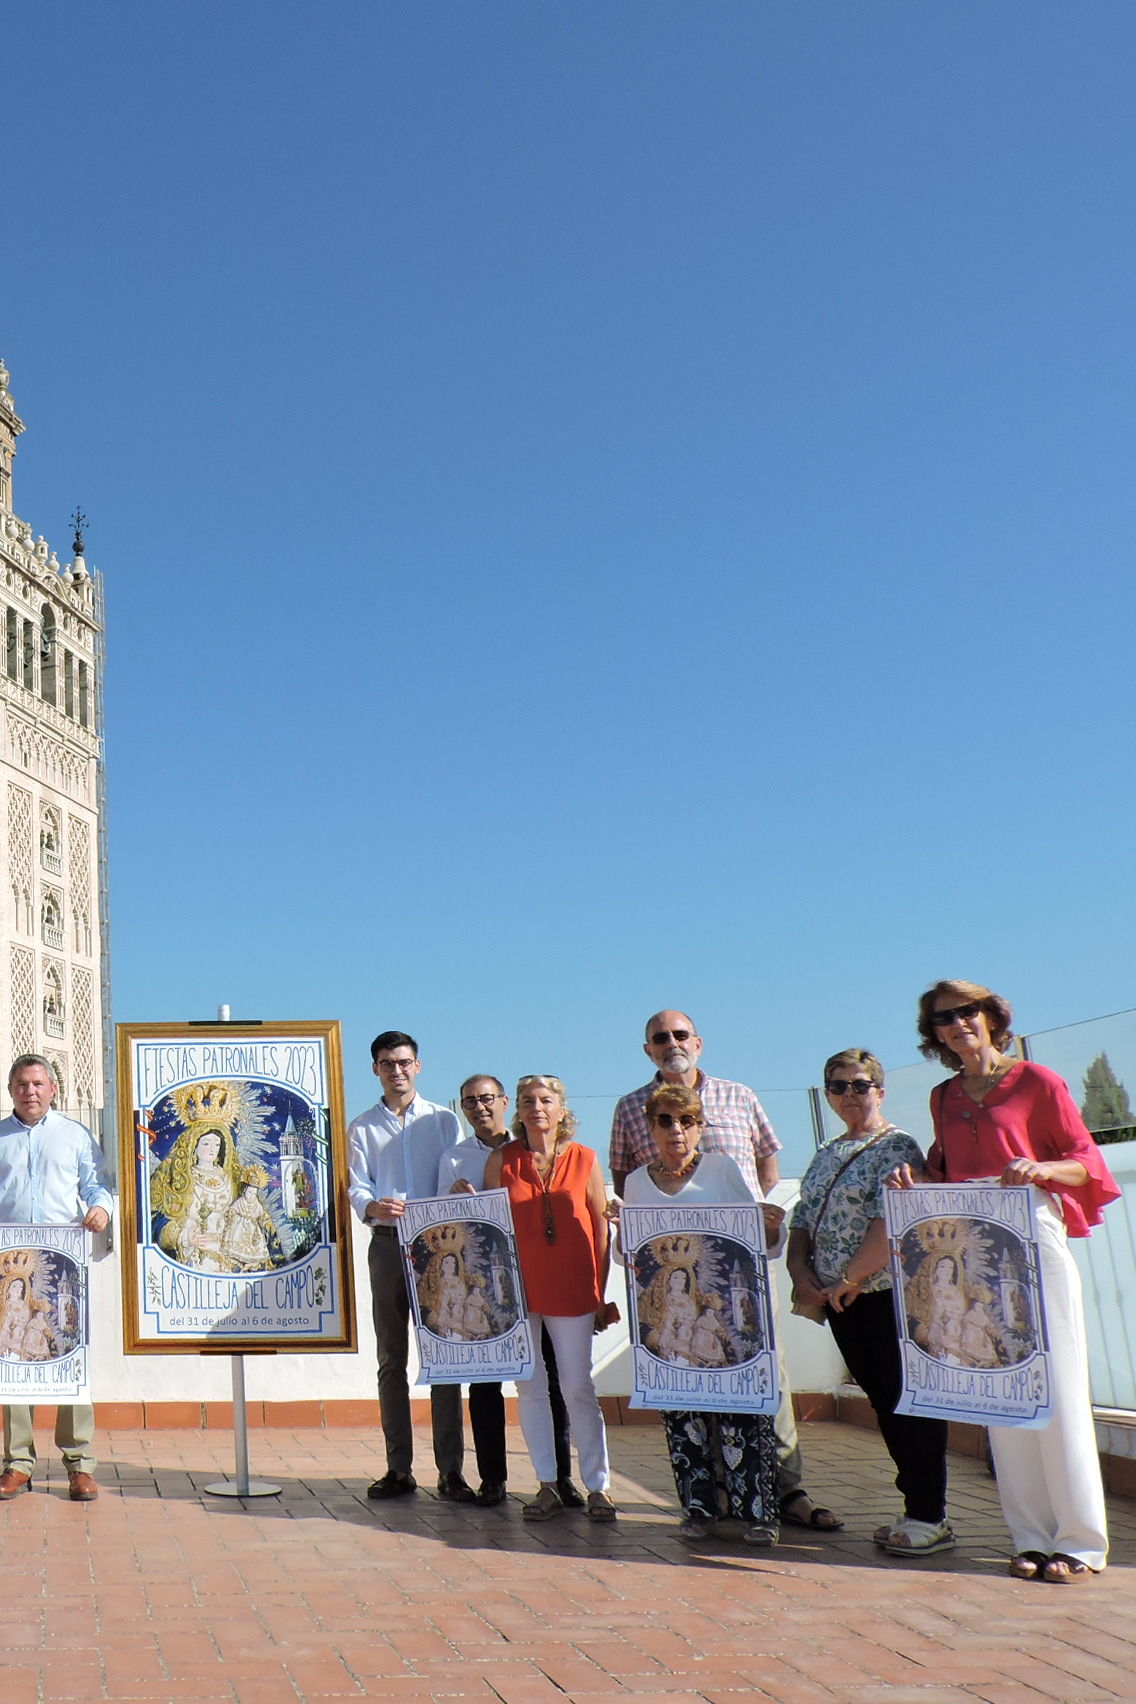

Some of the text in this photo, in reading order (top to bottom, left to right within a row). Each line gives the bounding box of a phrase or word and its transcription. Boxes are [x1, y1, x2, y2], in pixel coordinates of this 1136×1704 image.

[144, 1046, 316, 1097] FIESTAS PATRONALES 2023
[438, 1198, 485, 1218] PATRONALES
[892, 1192, 932, 1230] FIESTAS
[935, 1192, 995, 1216] PATRONALES
[14, 1228, 59, 1247] PATRONALES
[628, 1210, 755, 1246] FIESTAS PATRONALES 2023
[161, 1265, 314, 1309] CASTILLEJA DEL CAMPO
[170, 1316, 184, 1326] del
[187, 1317, 198, 1326] 31
[202, 1316, 214, 1326] de
[216, 1317, 237, 1328] julio
[252, 1317, 257, 1325] 6
[262, 1316, 273, 1325] de
[276, 1317, 309, 1328] agosto
[430, 1339, 475, 1365] CASTILLEJA
[478, 1346, 492, 1363] DEL
[35, 1366, 48, 1383] DEL
[52, 1357, 75, 1383] CAMPO
[648, 1361, 760, 1395] CASTILLEJA DEL CAMPO
[918, 1357, 1034, 1401] CASTILLEJA DEL CAMPO
